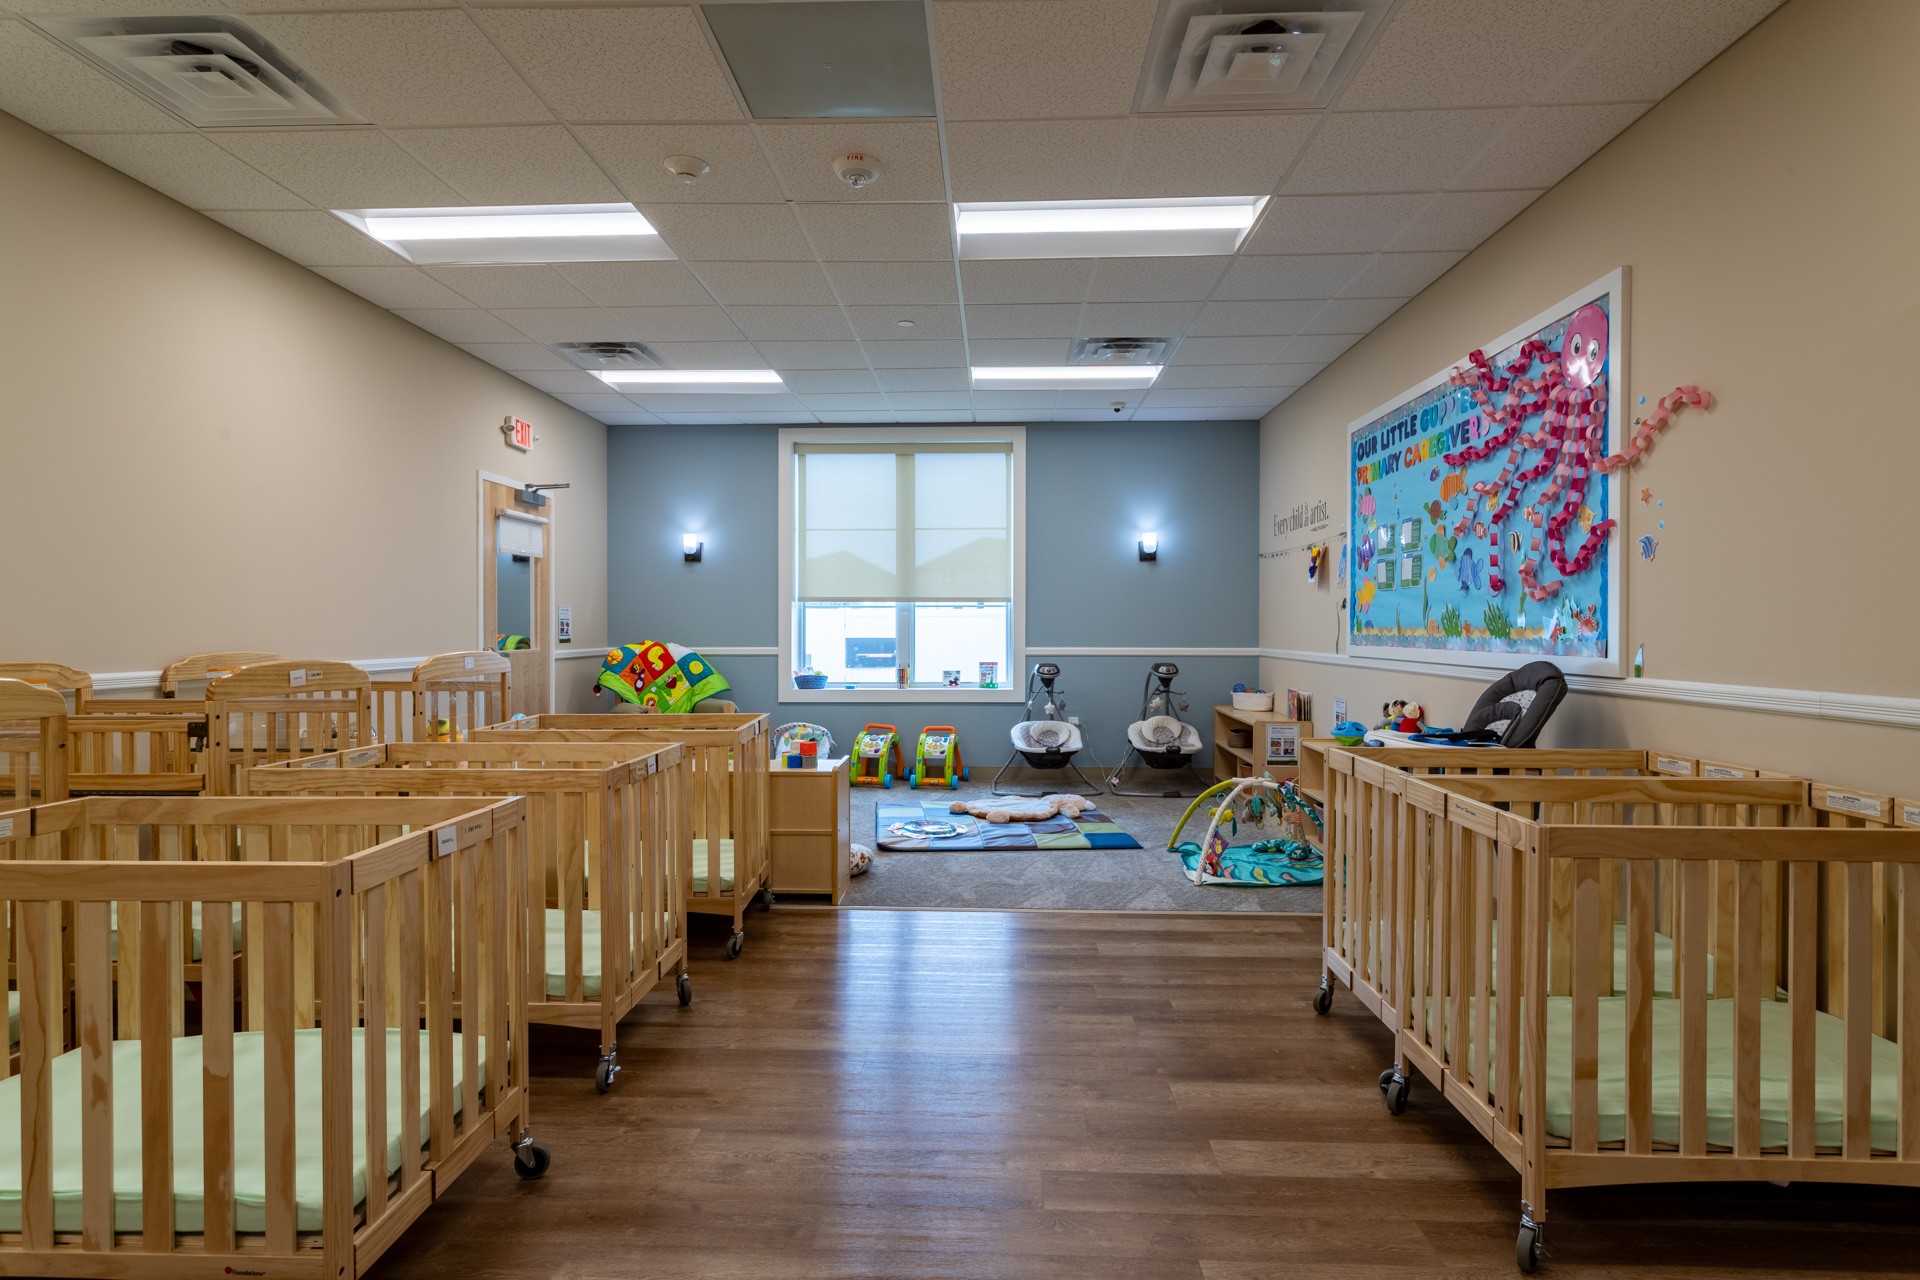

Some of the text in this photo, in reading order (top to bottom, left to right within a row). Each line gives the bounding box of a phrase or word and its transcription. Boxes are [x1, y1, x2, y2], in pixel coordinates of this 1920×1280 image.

[515, 418, 531, 448] EXIT
[1357, 435, 1378, 462] OUR
[1380, 414, 1417, 451] LITTLE
[1357, 412, 1490, 486] PRIMARY CAREGIVERS
[1273, 513, 1288, 540] Every
[1289, 504, 1304, 532] child
